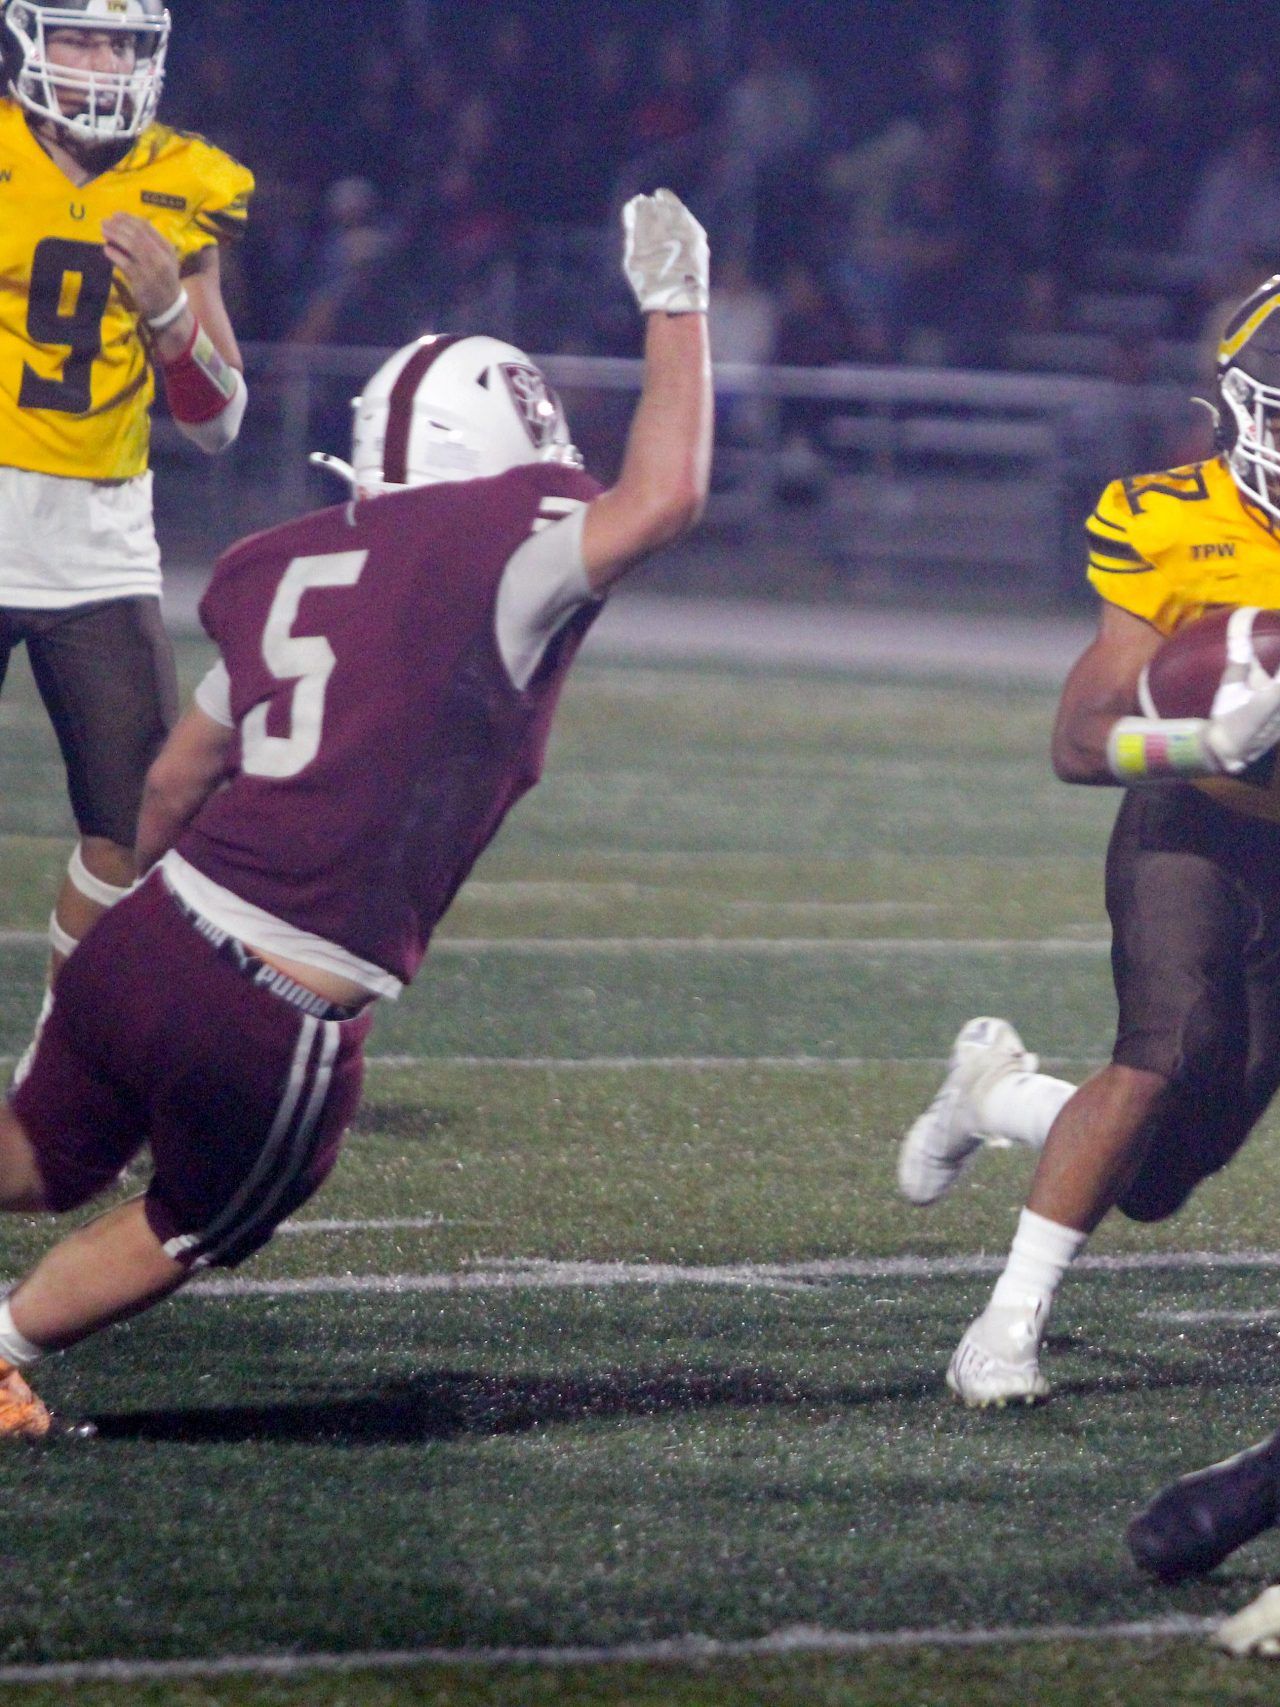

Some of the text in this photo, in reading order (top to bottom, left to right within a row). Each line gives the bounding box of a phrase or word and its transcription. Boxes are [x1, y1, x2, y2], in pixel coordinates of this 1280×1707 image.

[18, 236, 114, 414] 9
[1190, 543, 1236, 560] TPW
[241, 550, 369, 778] 5
